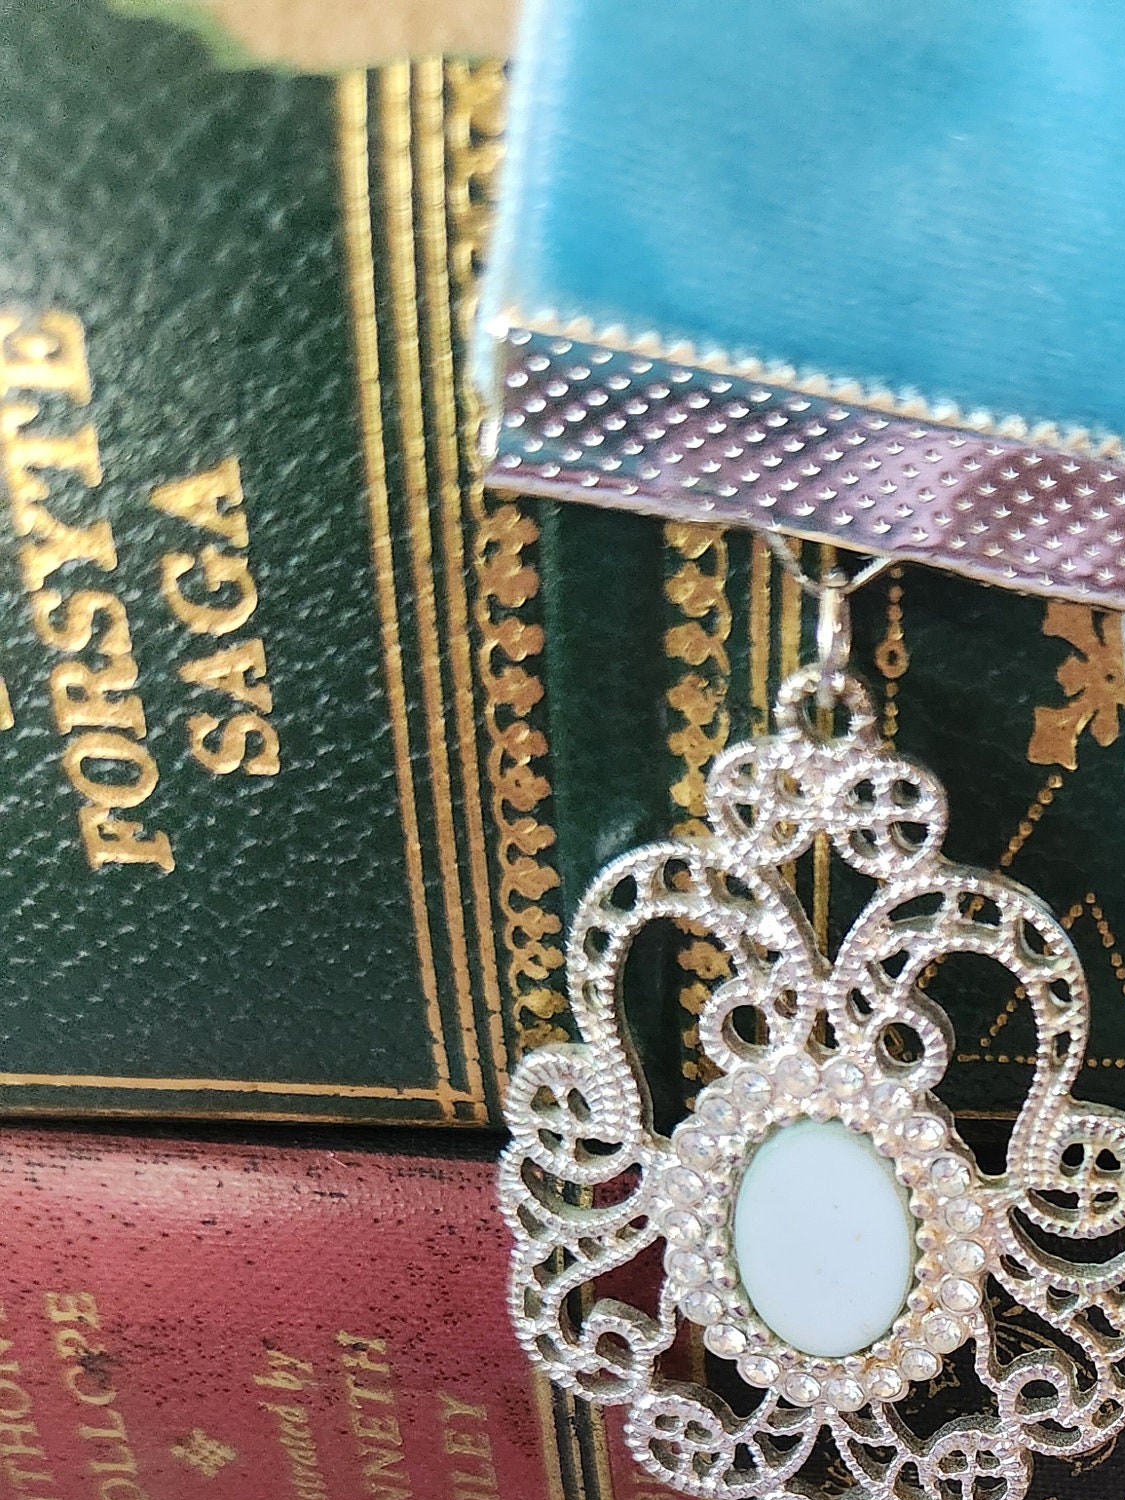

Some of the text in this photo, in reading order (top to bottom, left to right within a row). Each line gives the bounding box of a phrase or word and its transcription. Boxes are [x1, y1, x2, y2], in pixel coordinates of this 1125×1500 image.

[0, 308, 175, 873] FORSYTE
[150, 456, 281, 777] SAGA
[253, 1345, 314, 1390] by
